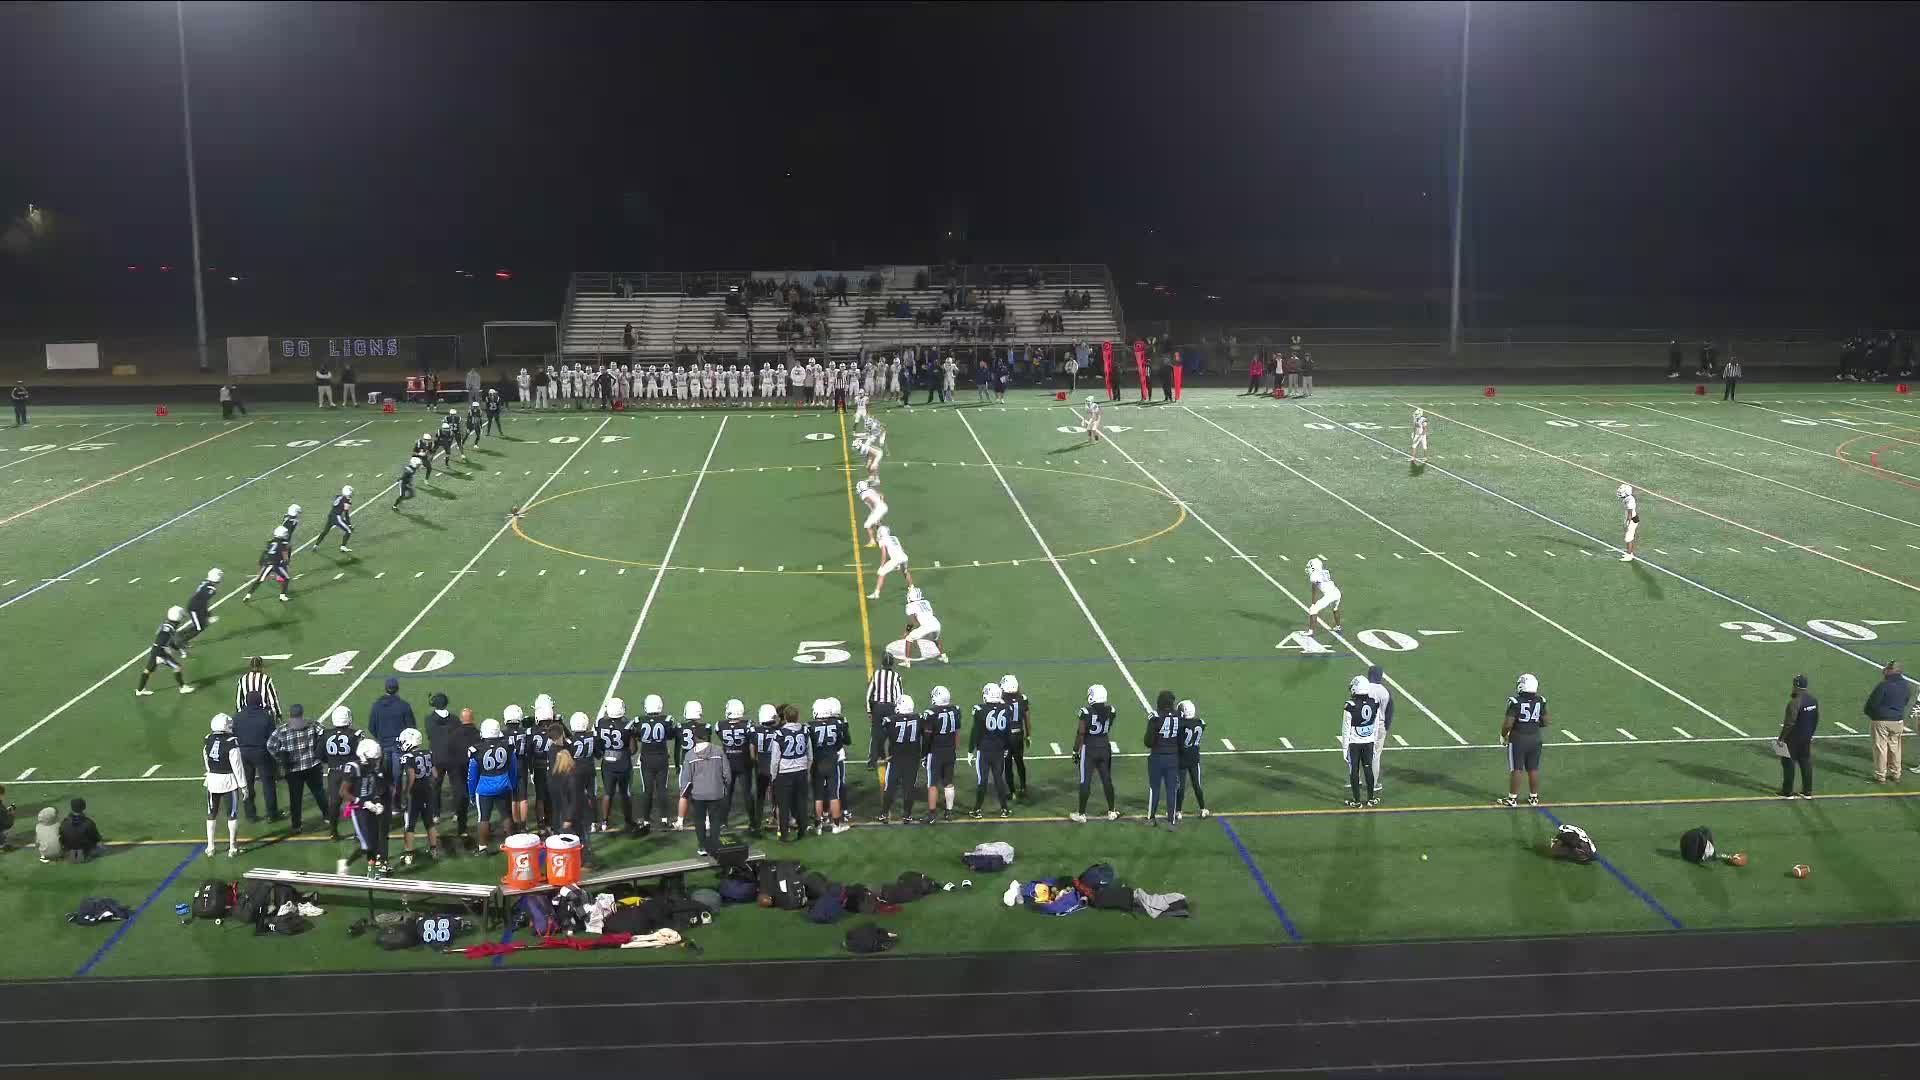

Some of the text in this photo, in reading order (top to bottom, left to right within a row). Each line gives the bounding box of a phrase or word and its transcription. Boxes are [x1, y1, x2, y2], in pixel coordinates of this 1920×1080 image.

[282, 338, 399, 358] GO LIONS
[1275, 629, 1420, 653] 40
[1719, 620, 1878, 643] 30
[292, 649, 456, 676] 40
[792, 638, 942, 664] 50
[938, 710, 956, 735] 71
[985, 709, 1007, 732] 66
[1360, 704, 1373, 725] 9
[1518, 702, 1541, 723] 54
[600, 728, 624, 750] 53
[640, 722, 665, 744] 20
[722, 728, 745, 747] 55
[815, 725, 837, 747] 75
[895, 719, 918, 743] 77
[1159, 716, 1179, 739] 41
[1184, 726, 1203, 747] 22
[208, 740, 221, 762] 4
[325, 734, 350, 756] 63
[573, 736, 594, 759] 27
[784, 734, 806, 757] 28
[414, 751, 432, 779] 35
[482, 746, 508, 771] 69
[515, 853, 529, 868] G
[552, 854, 564, 867] G
[423, 917, 450, 943] 88
